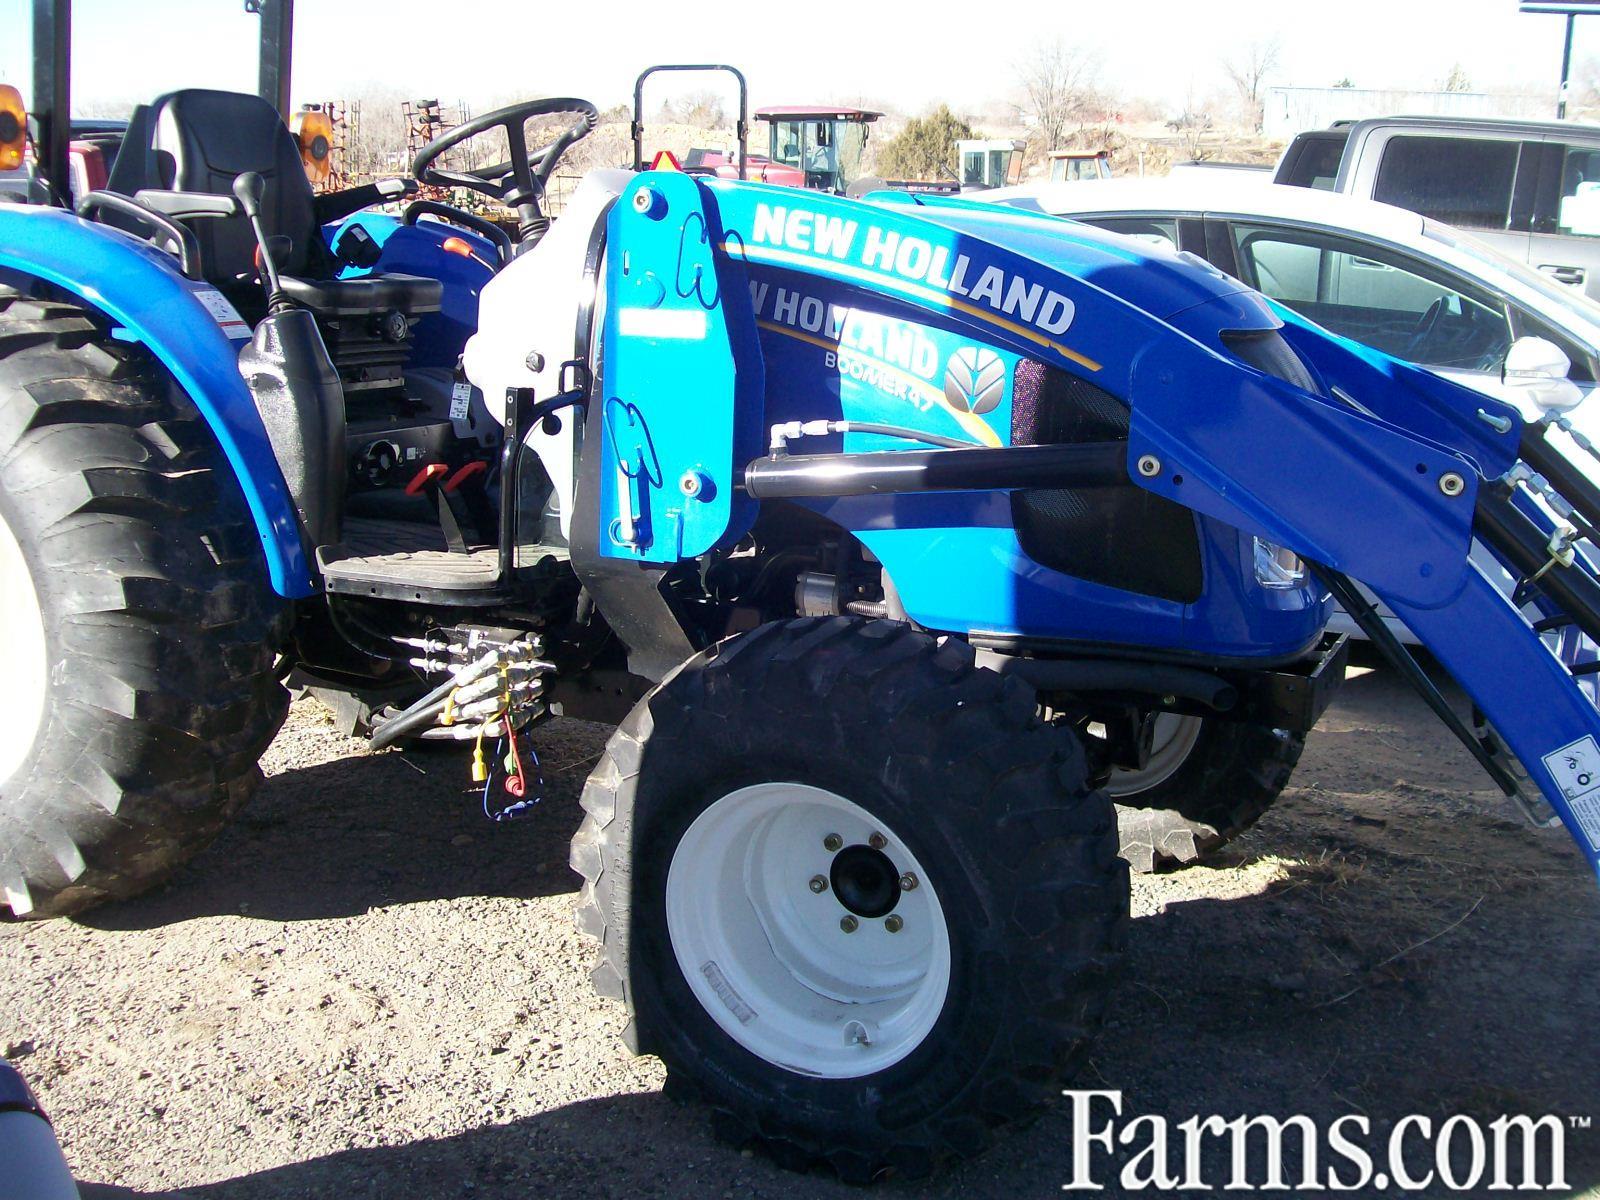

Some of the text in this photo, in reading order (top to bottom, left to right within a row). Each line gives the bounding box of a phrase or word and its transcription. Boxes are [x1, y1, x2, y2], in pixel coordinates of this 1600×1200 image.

[752, 203, 858, 259] NEW
[861, 227, 1076, 336] HOLLAND
[773, 288, 939, 380] HOLLAND
